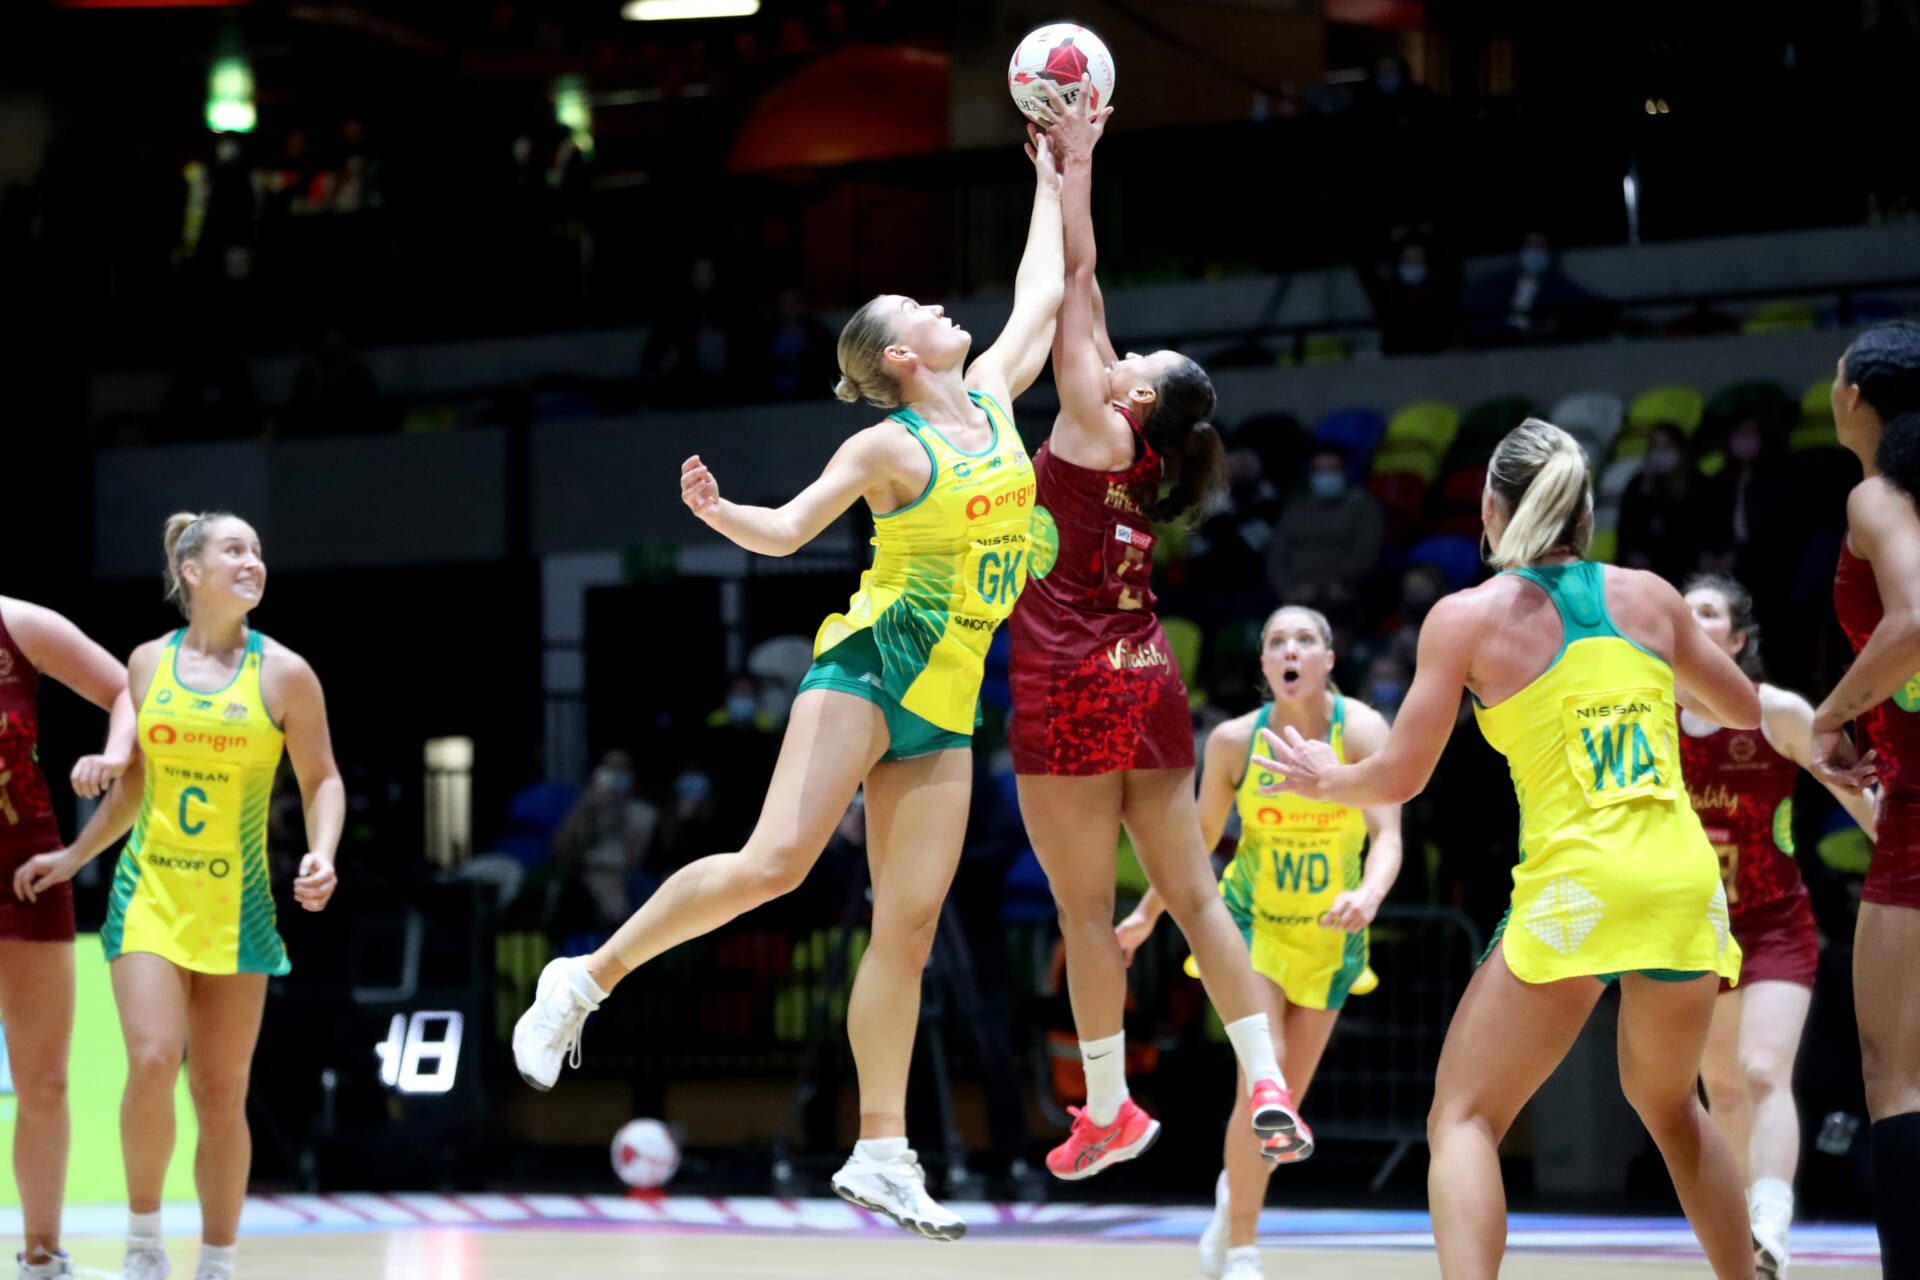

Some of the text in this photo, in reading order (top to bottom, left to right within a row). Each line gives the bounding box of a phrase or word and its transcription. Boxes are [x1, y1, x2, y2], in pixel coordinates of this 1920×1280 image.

[977, 534, 1026, 546] NISSAN
[978, 550, 1023, 605] GK
[1107, 638, 1171, 675] Vitality
[1576, 703, 1651, 719] NISSAN
[183, 731, 248, 752] origin
[1580, 722, 1661, 791] WA
[164, 765, 230, 783] NISSAN
[178, 786, 208, 836] C
[1288, 808, 1348, 827] origin
[1272, 849, 1330, 895] WD
